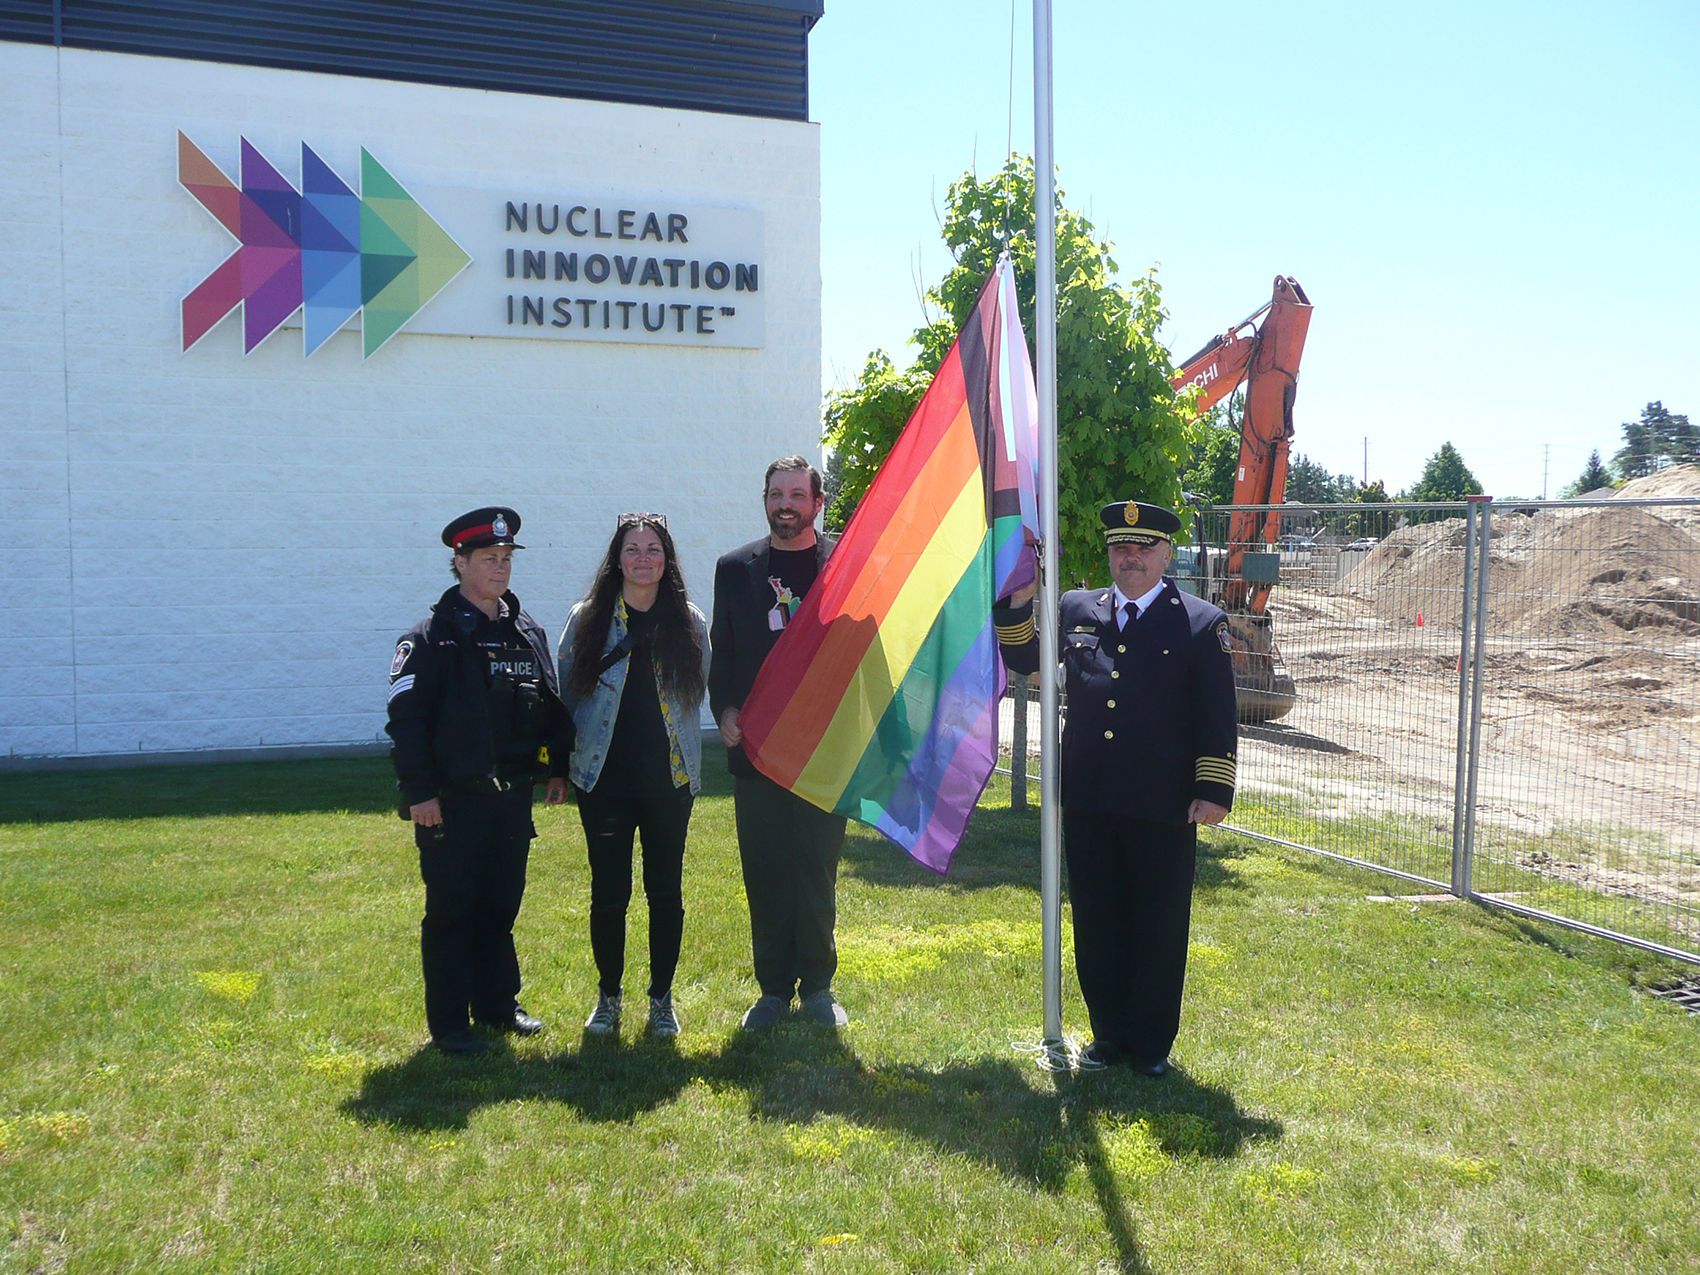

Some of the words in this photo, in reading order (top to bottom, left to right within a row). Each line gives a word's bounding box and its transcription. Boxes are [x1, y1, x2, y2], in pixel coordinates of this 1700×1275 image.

[505, 201, 689, 243] NUCLEAR
[506, 248, 759, 292] INNOVATION
[490, 661, 532, 675] POLICE
